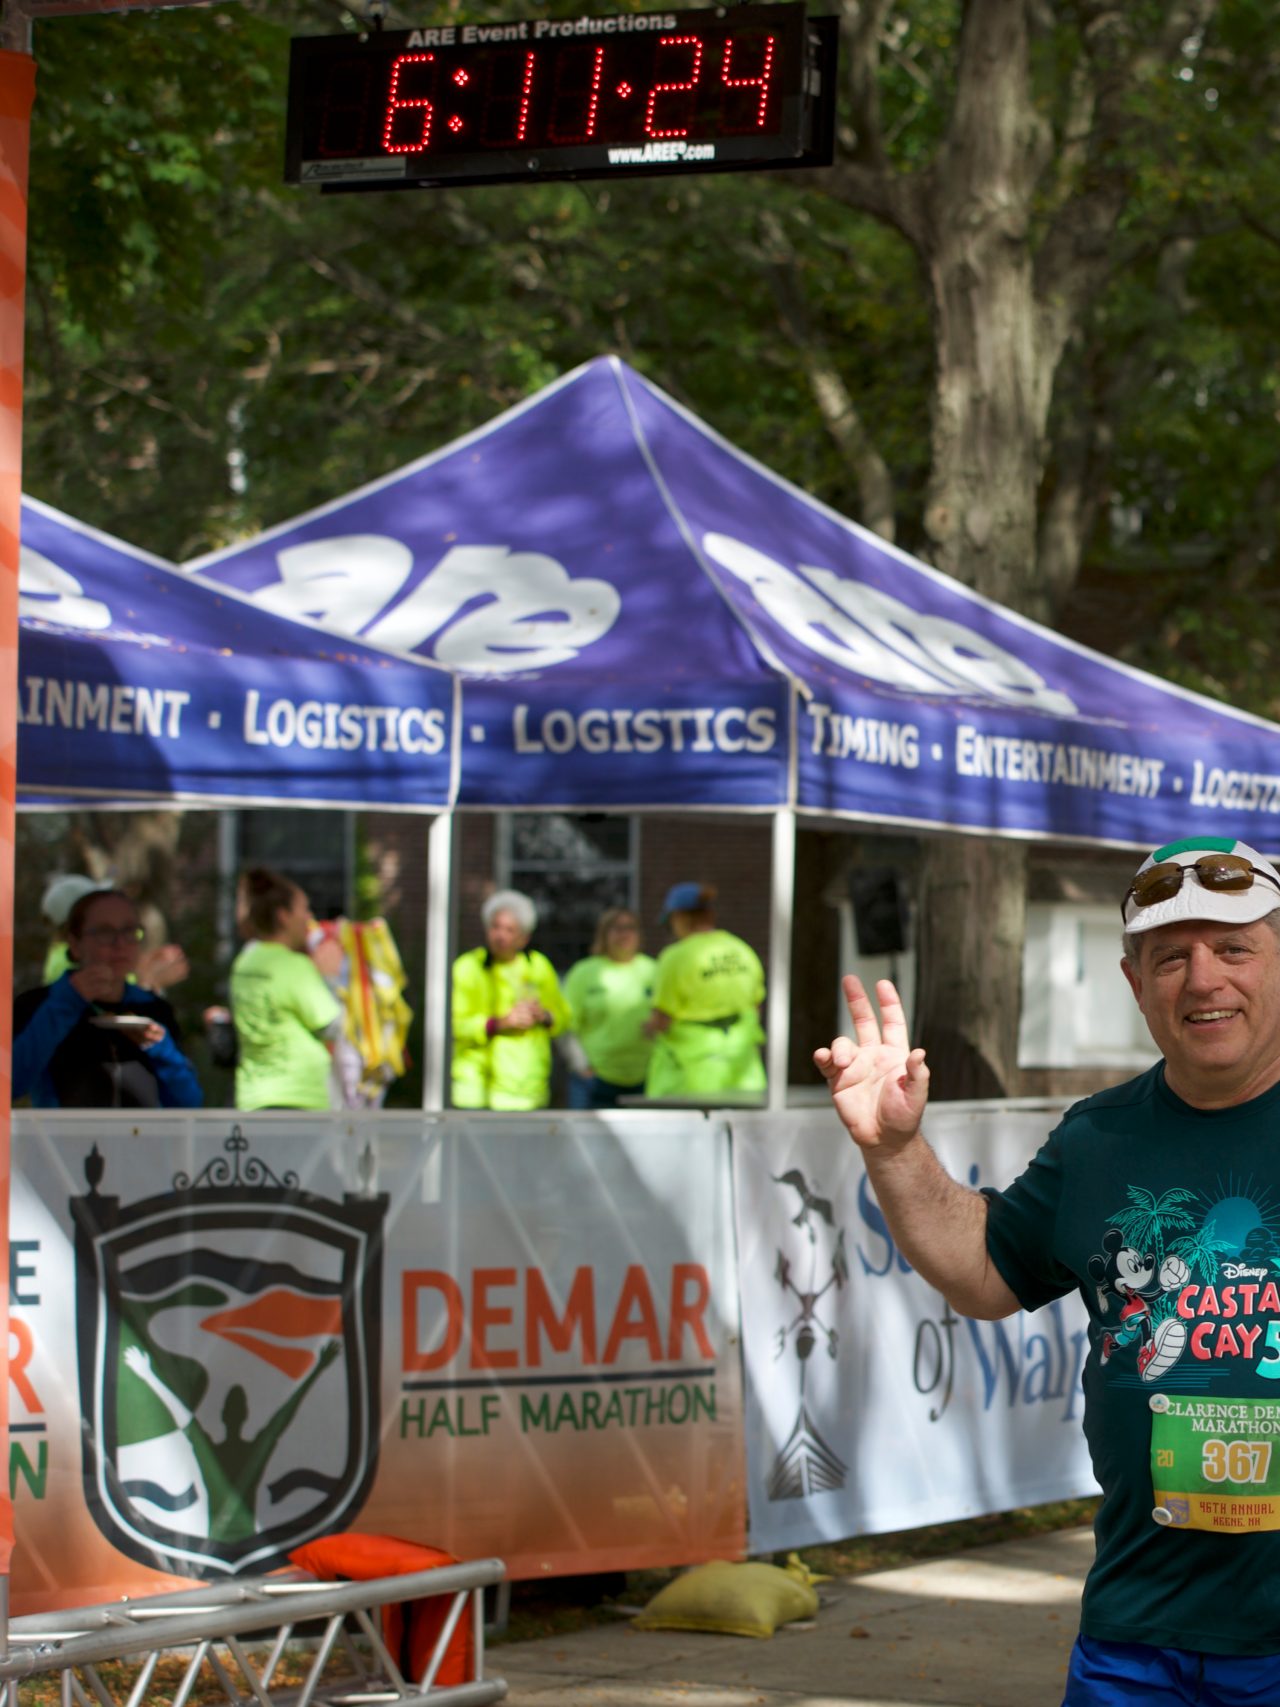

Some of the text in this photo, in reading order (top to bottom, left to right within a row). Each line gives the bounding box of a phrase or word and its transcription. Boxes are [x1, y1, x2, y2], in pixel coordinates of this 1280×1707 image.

[406, 14, 677, 48] ARE Event Productions
[18, 676, 445, 755] INMENT LOGISTICS
[513, 704, 777, 754] LOGISTICS
[807, 703, 919, 768] TIMING
[956, 724, 1165, 798] ENTERTAINMENT
[401, 1263, 717, 1374] DEMAR
[1190, 1321, 1262, 1360] CAY
[913, 1297, 1088, 1422] of Walp
[401, 1383, 719, 1440] HALF MARATHON
[1165, 1402, 1249, 1420] CLARENCE
[1156, 1449, 1174, 1467] 20
[1202, 1439, 1272, 1483] 367
[1200, 1502, 1275, 1516] 46TH ANNUAL
